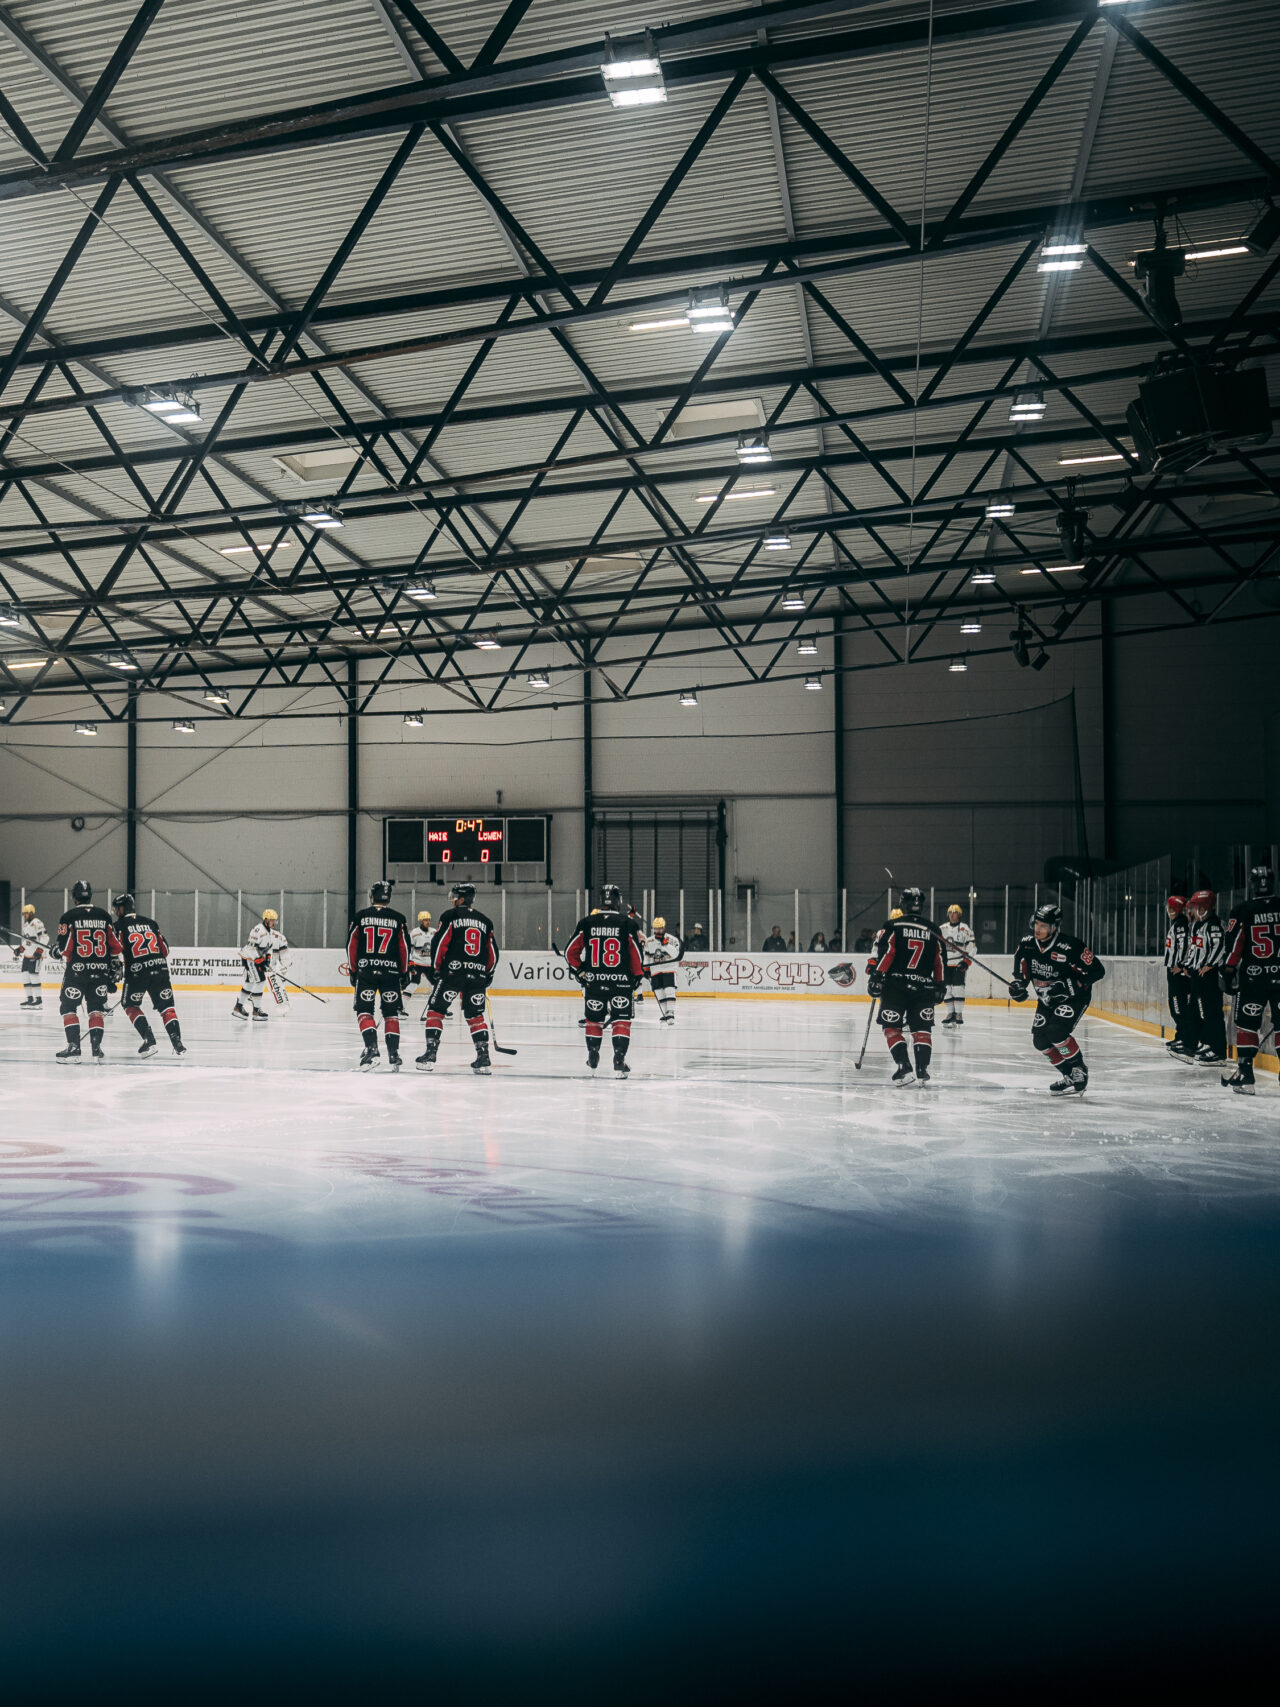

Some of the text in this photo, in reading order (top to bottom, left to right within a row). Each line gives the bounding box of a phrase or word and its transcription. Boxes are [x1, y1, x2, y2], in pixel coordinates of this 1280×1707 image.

[456, 819, 483, 832] 0:47
[428, 832, 448, 842] HAIE
[442, 850, 489, 863] 0 0
[361, 917, 398, 928] SENNHENN
[1254, 913, 1280, 924] AUST
[591, 927, 620, 937] CURRIE
[902, 928, 930, 940] BAILEN
[77, 929, 106, 957] 53
[129, 932, 160, 958] 22
[364, 926, 392, 954] 17
[464, 927, 481, 956] 9
[589, 937, 620, 968] 18
[907, 939, 925, 970] 7
[170, 959, 241, 967] JETZT MITGLIE
[370, 959, 398, 968] TOYOTA
[1032, 959, 1053, 972] Rhein
[170, 968, 213, 976] WERDEN!
[766, 961, 825, 986] CLUB
[270, 974, 284, 1004] techem
